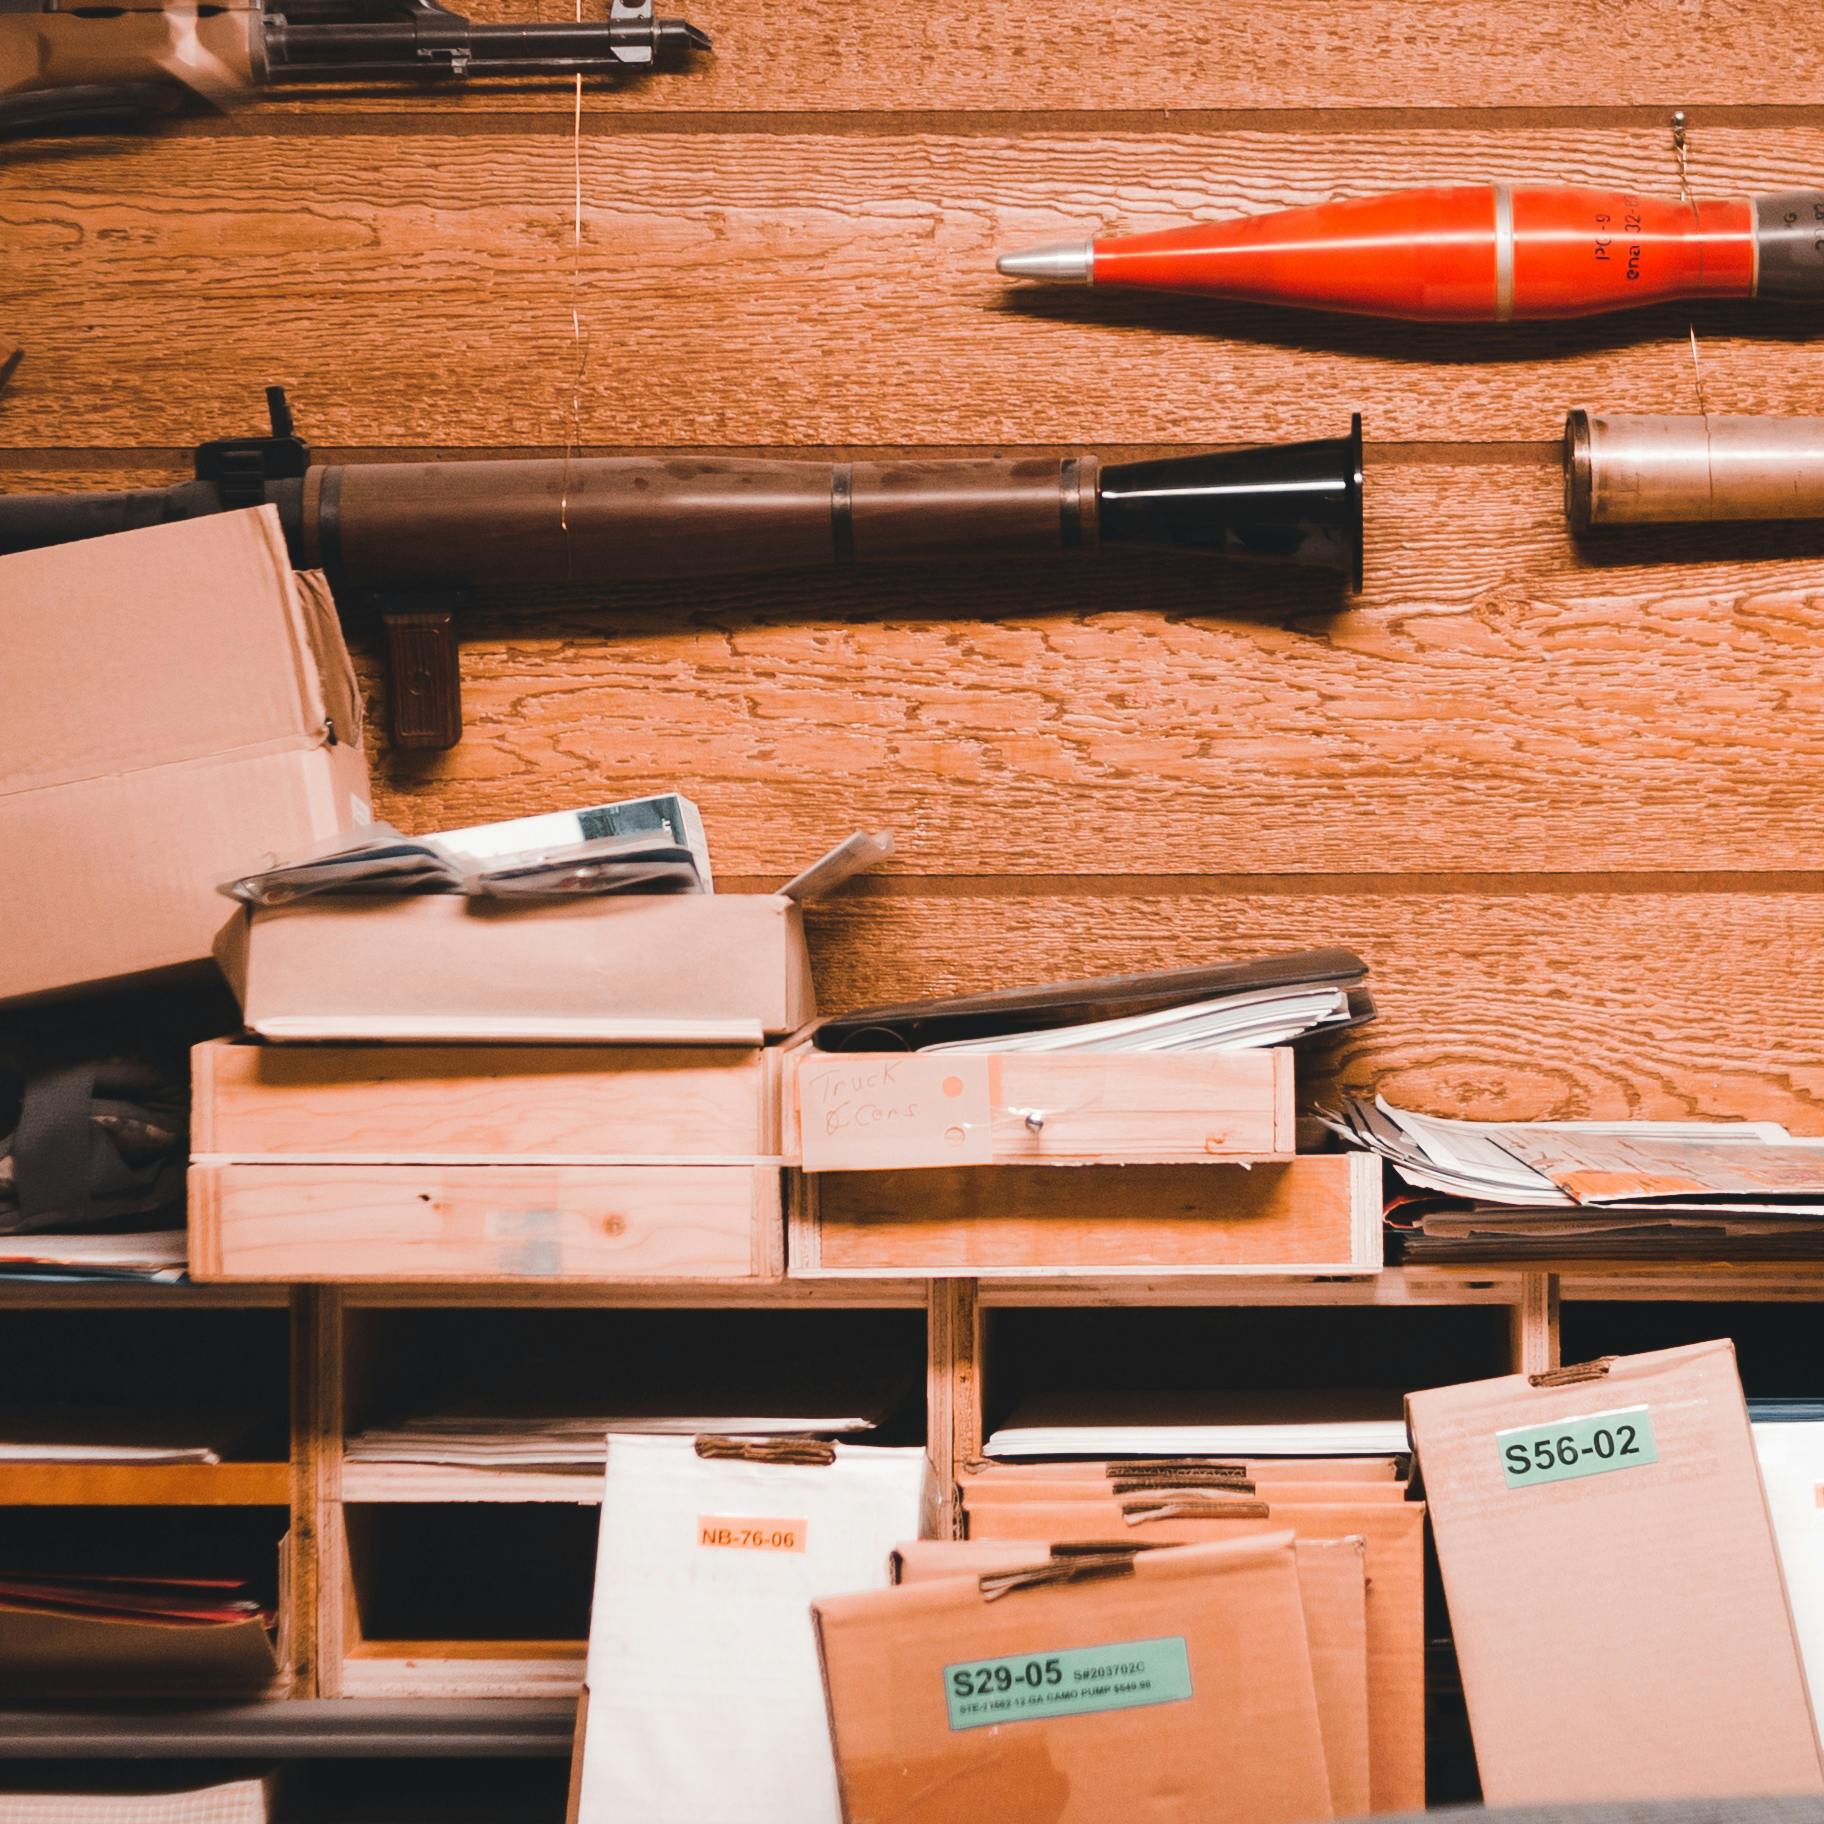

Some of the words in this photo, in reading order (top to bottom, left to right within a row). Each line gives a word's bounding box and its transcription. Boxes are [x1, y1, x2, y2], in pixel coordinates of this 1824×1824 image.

[809, 1061, 903, 1102] Truck
[1504, 1424, 1641, 1476] S56-02
[701, 1527, 796, 1549] NB-76-06
[952, 1657, 1064, 1698] S29-05
